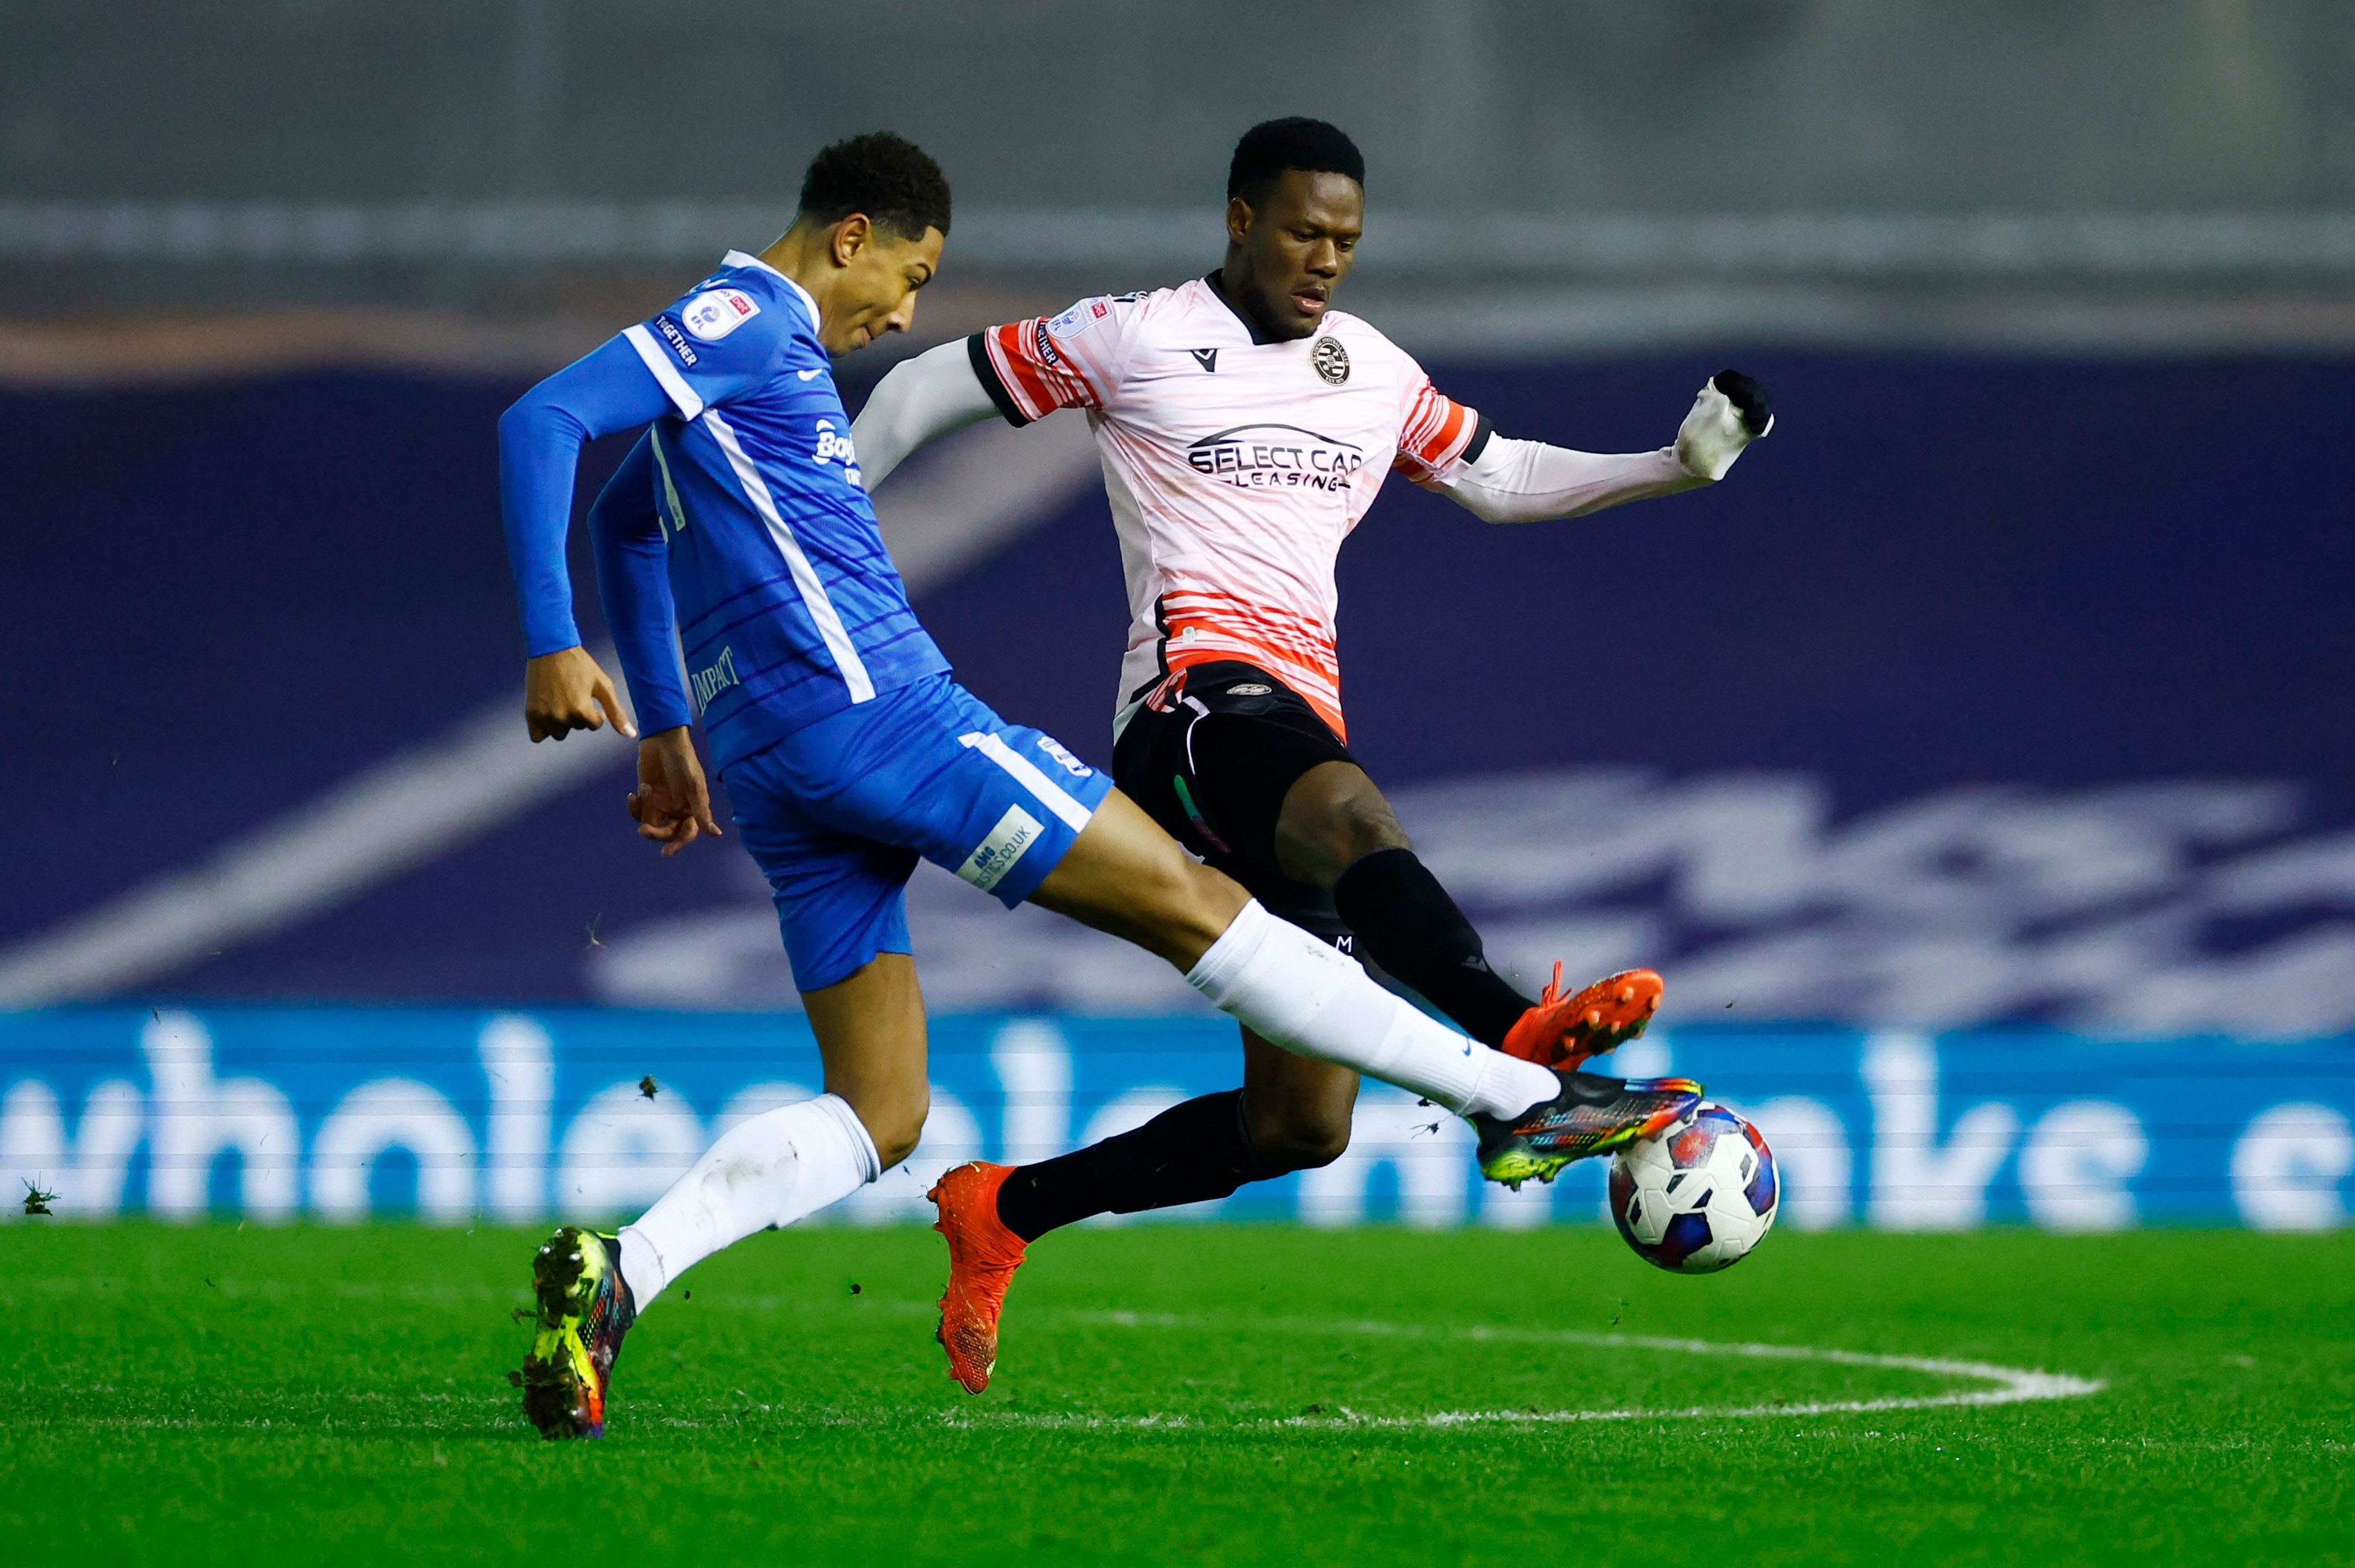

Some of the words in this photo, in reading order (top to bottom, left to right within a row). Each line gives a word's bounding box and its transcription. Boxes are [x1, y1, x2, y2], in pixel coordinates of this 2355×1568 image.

[1094, 303, 1106, 317] bet
[690, 315, 704, 330] EFL
[1052, 319, 1063, 332] EFL
[655, 315, 697, 367] TOGETHER
[1189, 446, 1303, 474] SELECT
[973, 846, 996, 869] AMG
